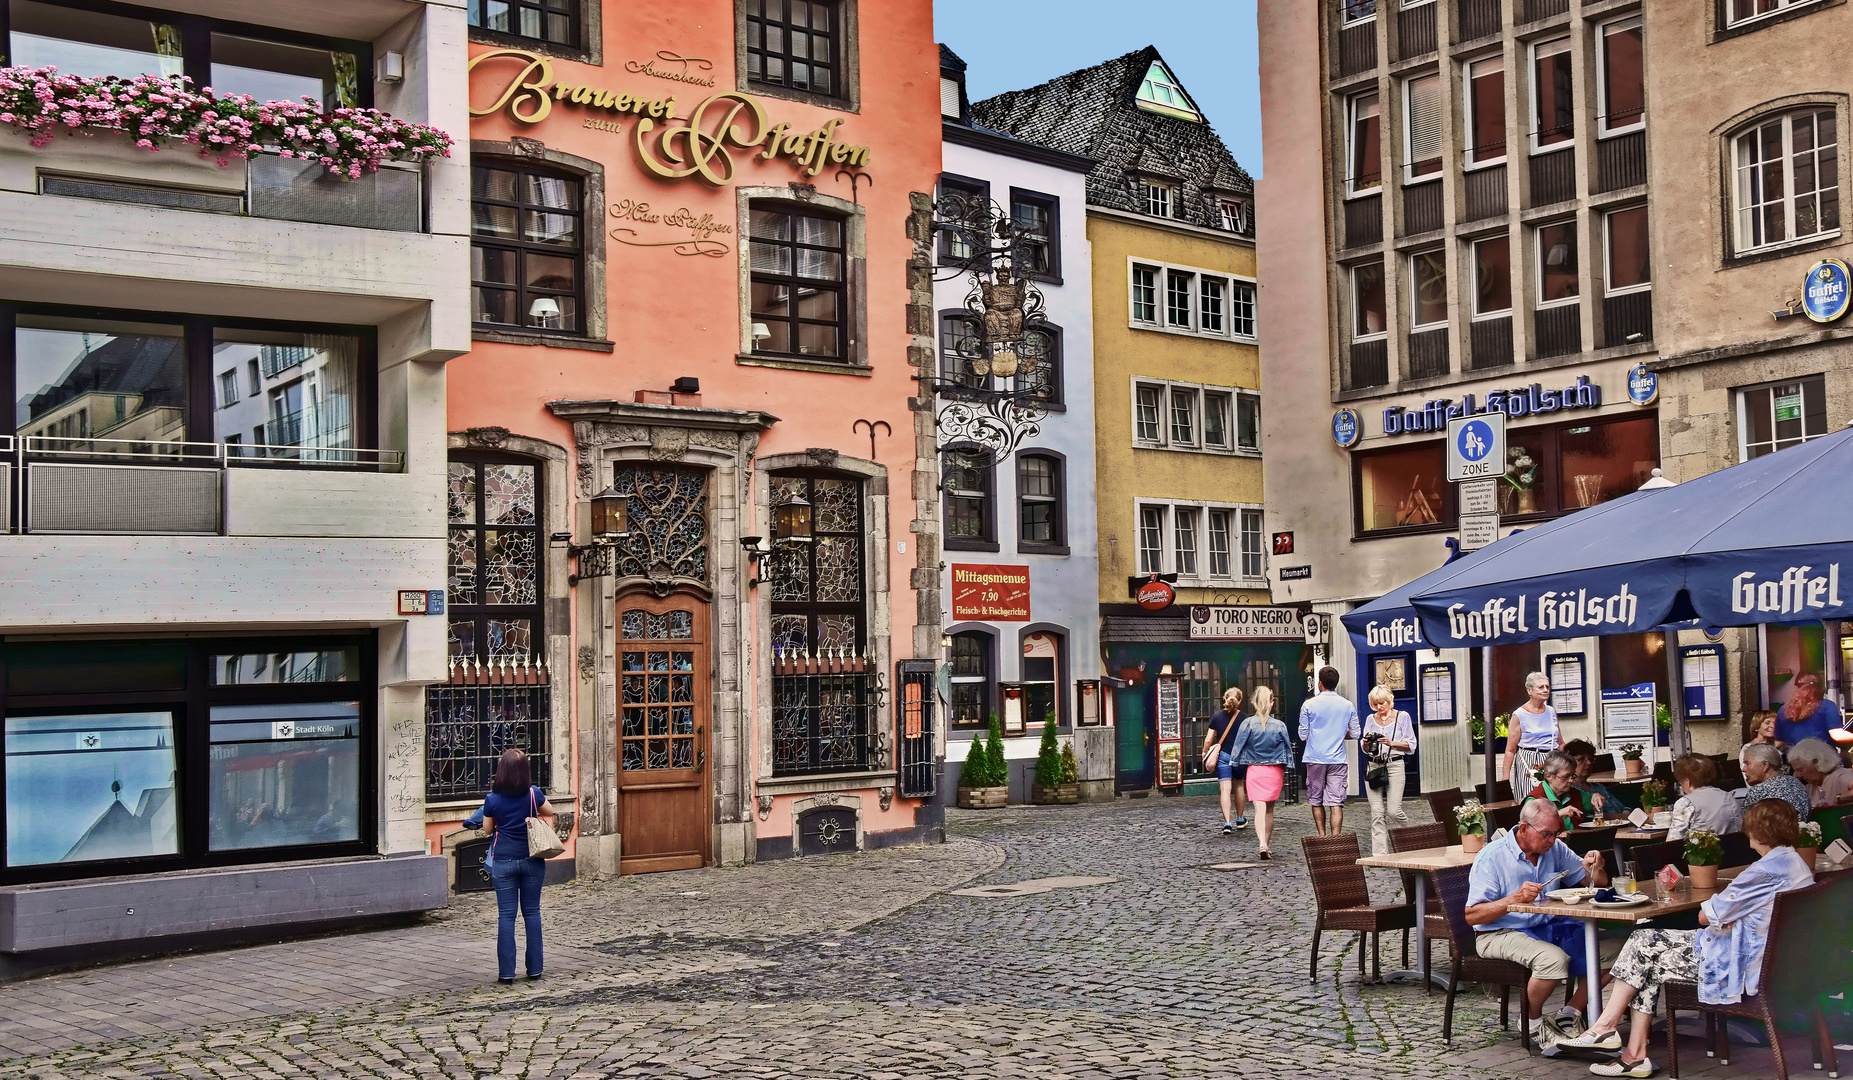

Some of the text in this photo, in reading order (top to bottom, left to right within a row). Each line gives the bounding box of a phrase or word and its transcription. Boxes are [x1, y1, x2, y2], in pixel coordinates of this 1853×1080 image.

[625, 52, 715, 88] Ausschank
[469, 49, 676, 123] Brauerei
[583, 117, 622, 133] zum
[637, 91, 871, 186] Pfaffen
[609, 199, 660, 223] Max
[1809, 281, 1844, 298] Gaffel
[1630, 377, 1654, 389] Gaffel
[1335, 422, 1354, 432] Gaffel
[1462, 463, 1490, 476] ZONE
[955, 570, 1026, 586] Mittagsmenue
[1281, 567, 1309, 578] Heumarkt
[1732, 562, 1844, 614] Gaffel
[981, 592, 999, 602] 7,90
[956, 605, 1028, 617] Fleisch- & Fischgerichte
[1214, 609, 1292, 624] TORO NEGRO
[1447, 583, 1637, 640] Gaffel Kölsch
[1191, 626, 1305, 635] GRILL-RESTAURAN
[1365, 616, 1422, 648] Gaffel
[295, 723, 335, 734] Stadt Köln
